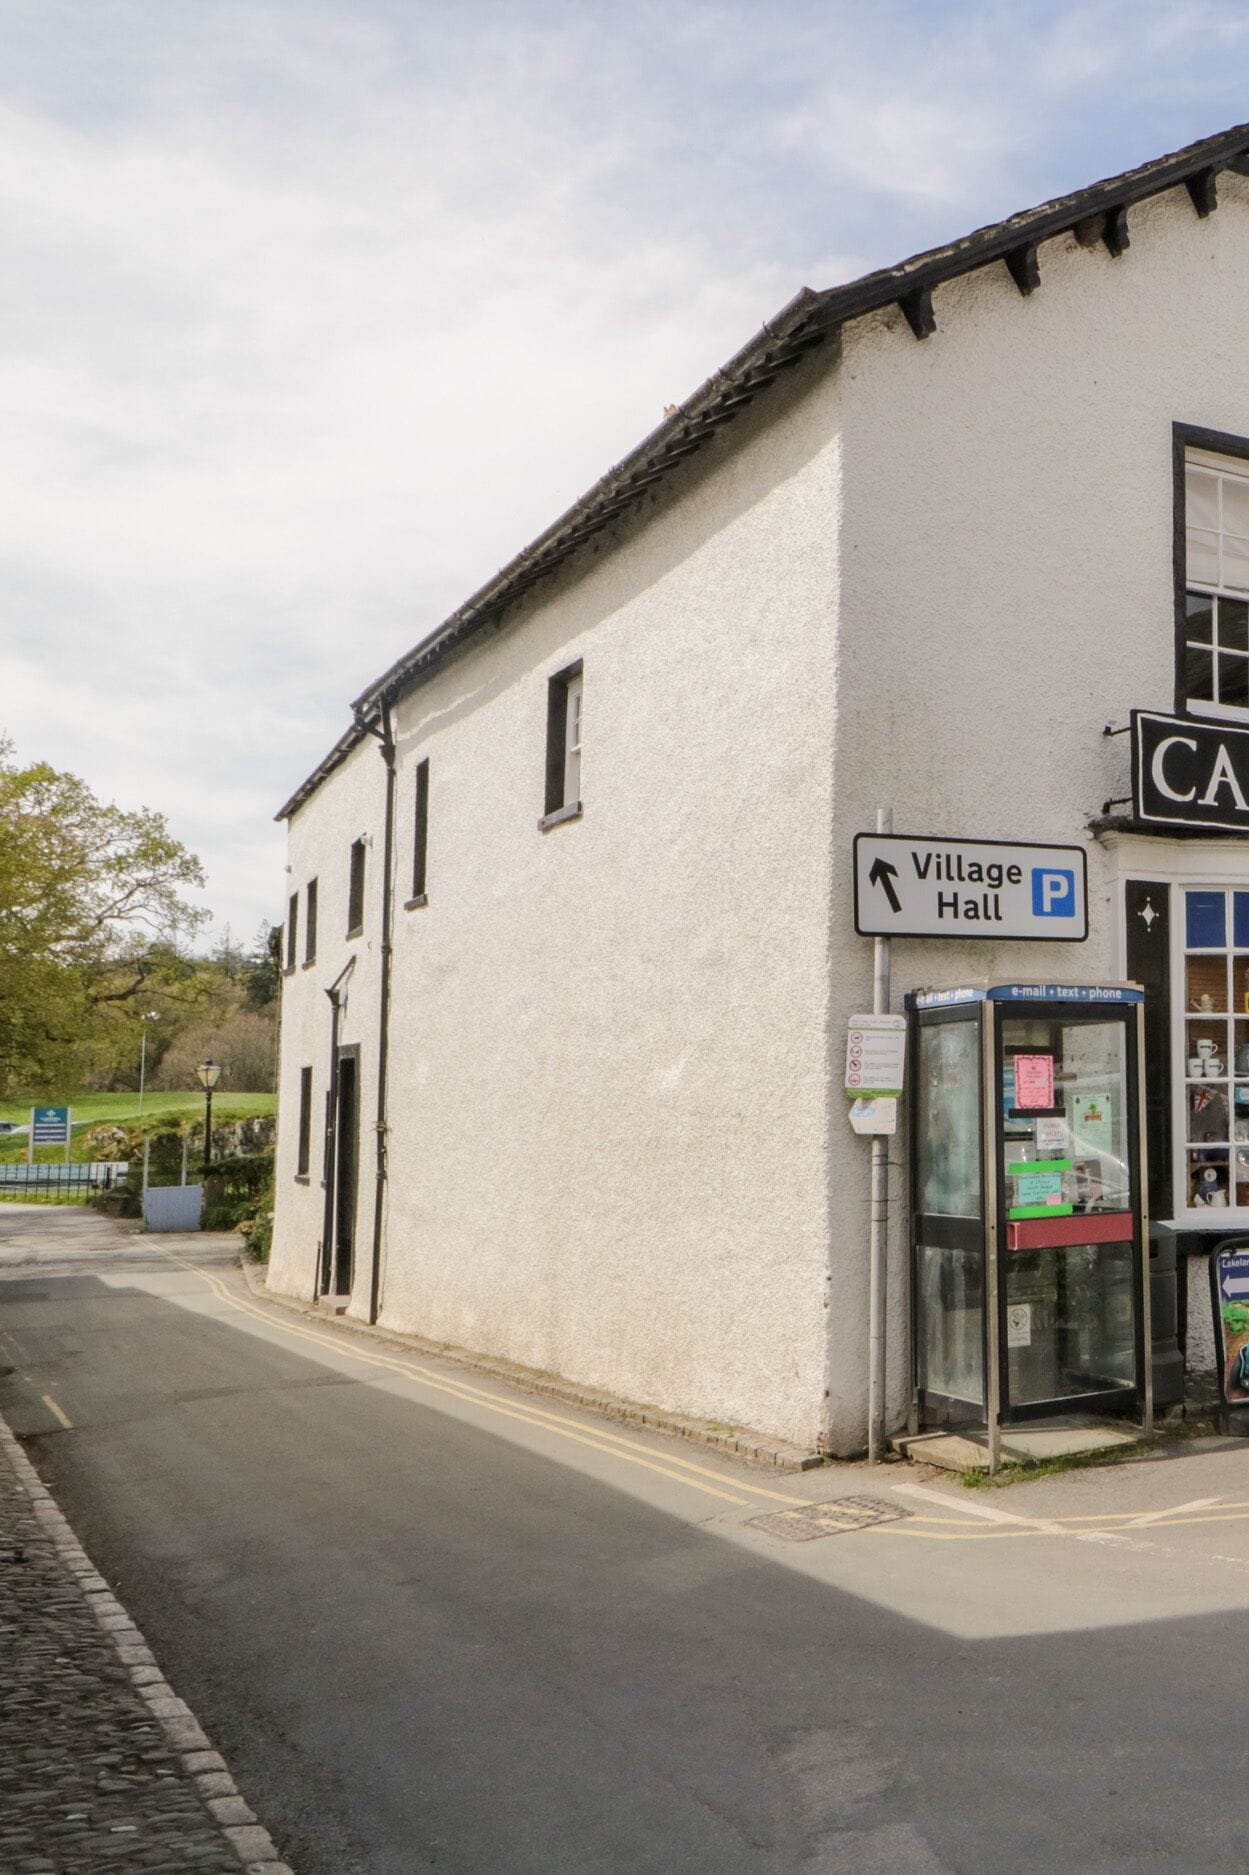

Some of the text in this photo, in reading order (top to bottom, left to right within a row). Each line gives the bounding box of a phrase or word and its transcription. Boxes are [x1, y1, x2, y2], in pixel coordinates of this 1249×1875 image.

[911, 852, 1069, 912] Village P
[937, 891, 1003, 921] Hall
[1011, 986, 1046, 997] e-mail
[1057, 986, 1079, 997] text
[1089, 986, 1122, 999] phone
